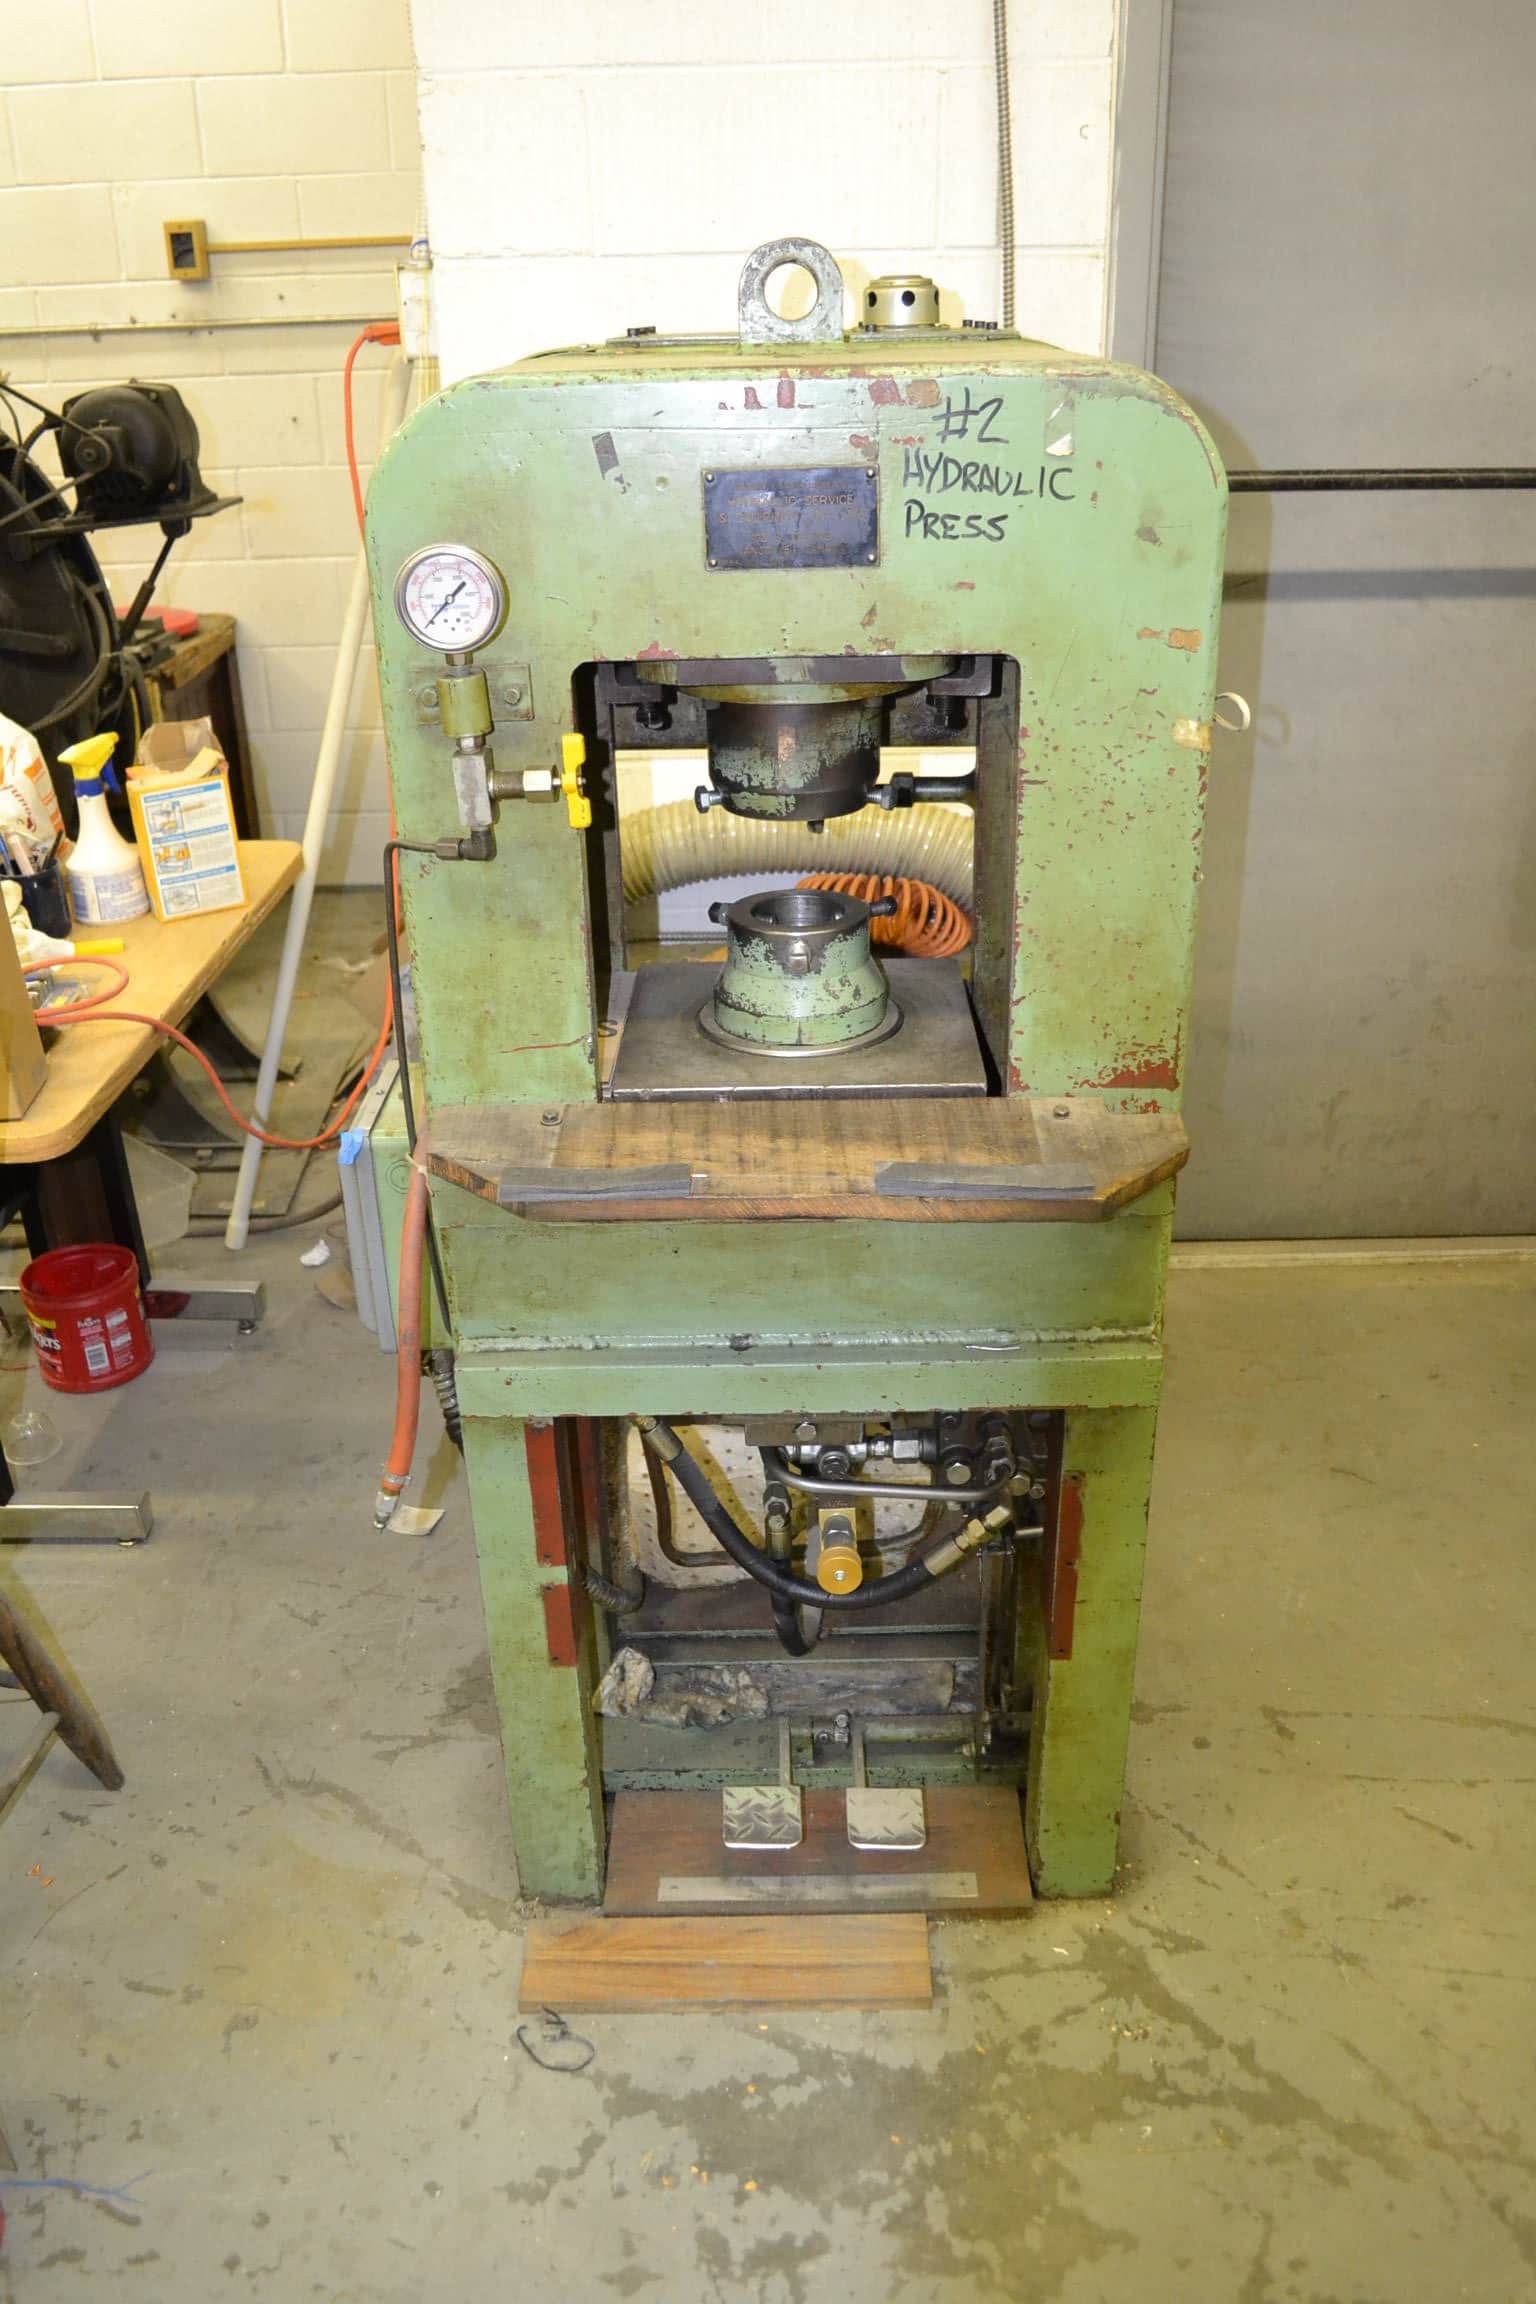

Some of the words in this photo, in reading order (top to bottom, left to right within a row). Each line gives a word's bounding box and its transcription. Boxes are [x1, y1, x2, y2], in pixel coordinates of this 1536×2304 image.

[931, 386, 1010, 444] #2
[902, 447, 1076, 501] HYDRAULIC
[803, 493, 856, 506] SERVICE
[904, 498, 1009, 542] PRESS
